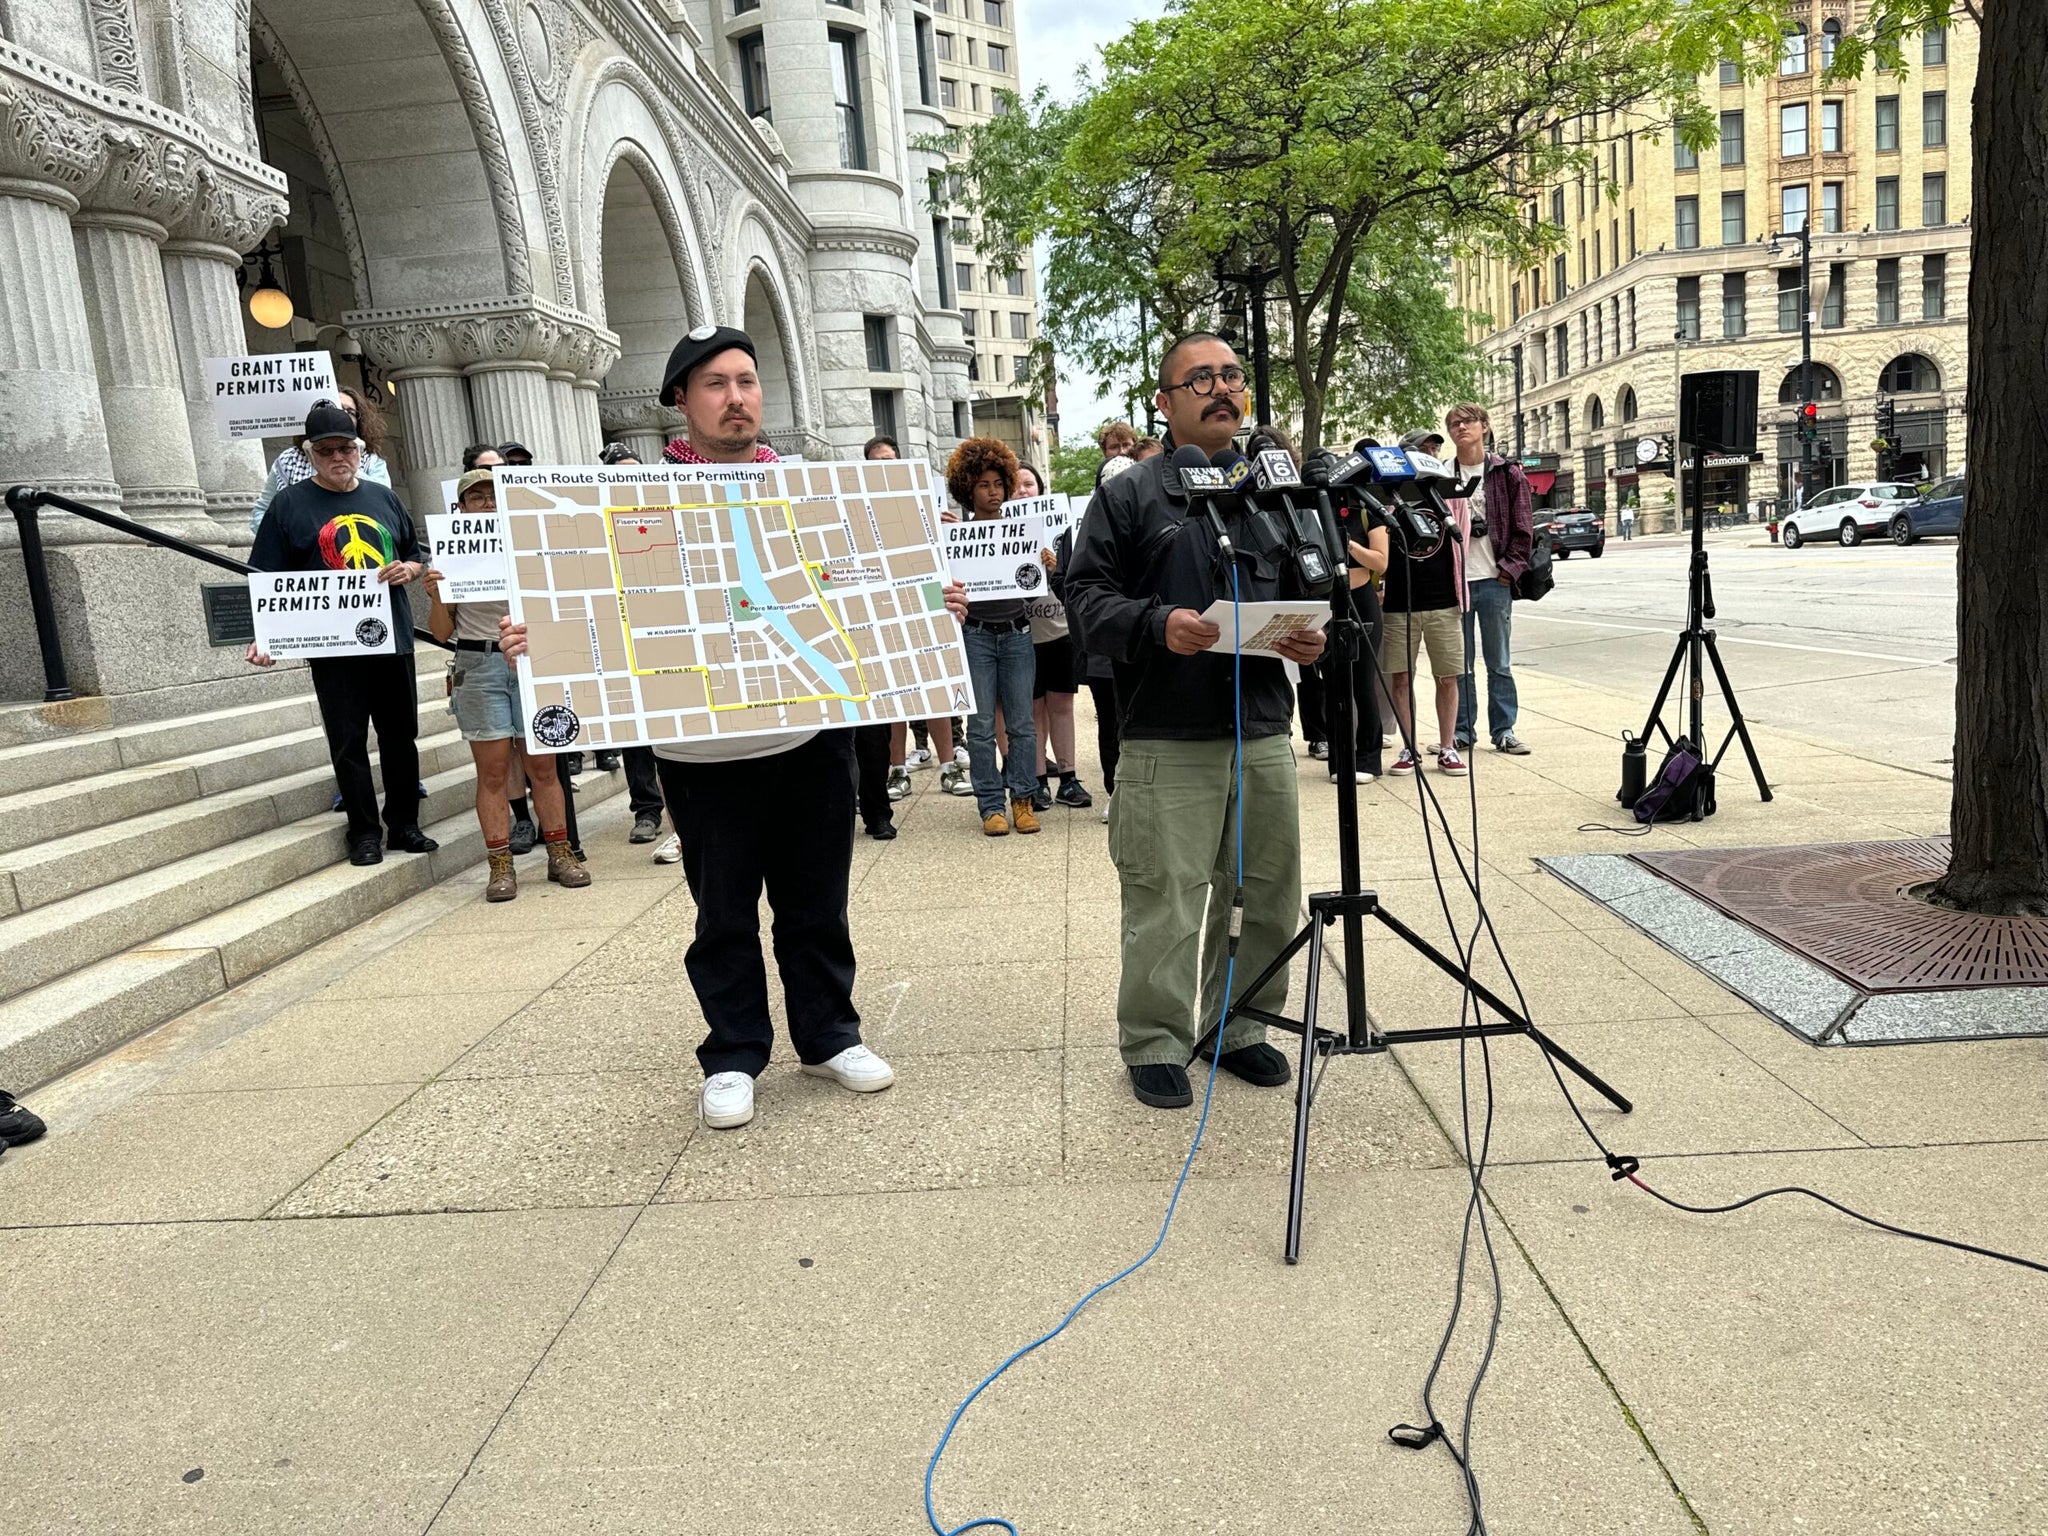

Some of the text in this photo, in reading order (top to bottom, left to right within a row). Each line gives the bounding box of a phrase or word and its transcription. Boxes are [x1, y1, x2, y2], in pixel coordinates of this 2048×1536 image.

[231, 358, 315, 376] GRANT THE
[216, 375, 330, 396] PERMITS NOW!
[1273, 462, 1290, 477] 6
[1681, 455, 1750, 468] Alln Edmonds
[501, 471, 766, 484] March Route Submitted for Permitting
[1190, 474, 1223, 484] 89.7
[1256, 471, 1266, 490] 6
[1328, 464, 1350, 483] NEWS
[1000, 499, 1056, 518] ANT THE
[922, 514, 932, 538] JACKSON
[1046, 513, 1068, 527] OW!
[950, 524, 1026, 542] GRANT THE
[793, 534, 802, 554] WATER
[946, 544, 996, 560] ERMITS
[1002, 540, 1038, 556] NOW!
[682, 553, 691, 578] PHILLIPS
[274, 575, 366, 592] GRANT THE
[898, 578, 924, 586] KILBOURN
[991, 584, 1016, 592] CONVENTION
[258, 594, 382, 612] PERMITS NOW!
[766, 604, 800, 612] Marquette
[590, 625, 598, 644] JAMES
[654, 628, 686, 636] KILBOURN
[882, 688, 912, 697] WISCONSIN
[754, 701, 788, 709] WISCONSIN
[534, 706, 553, 727] COALITION
